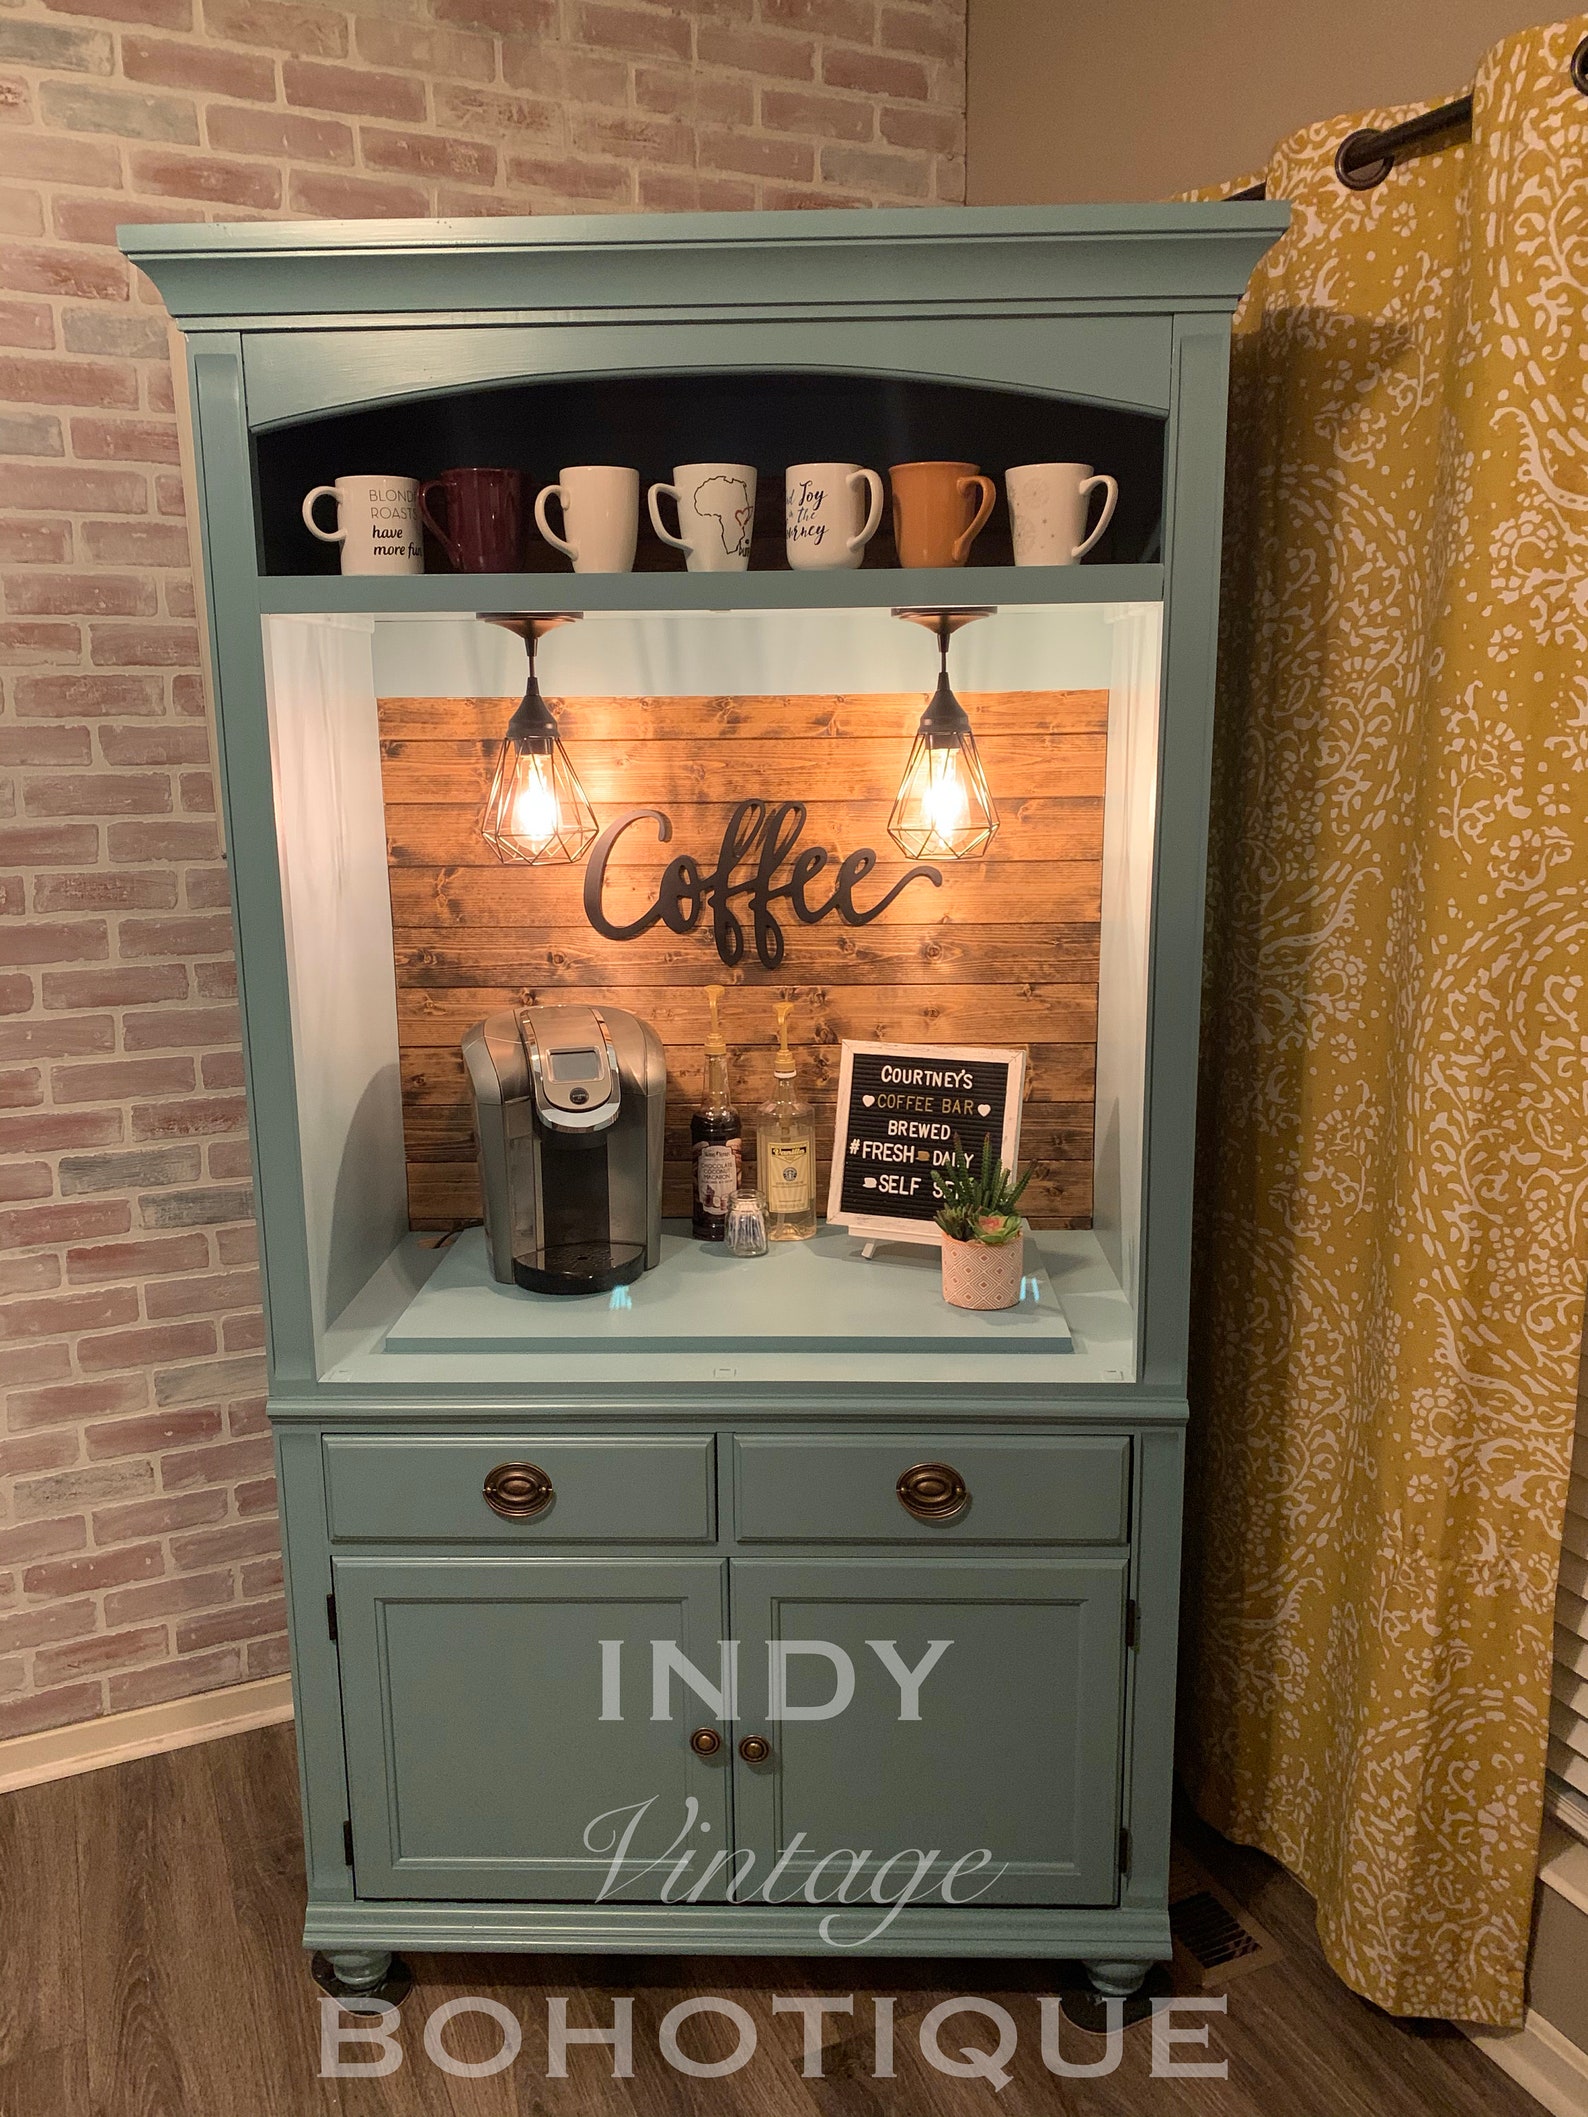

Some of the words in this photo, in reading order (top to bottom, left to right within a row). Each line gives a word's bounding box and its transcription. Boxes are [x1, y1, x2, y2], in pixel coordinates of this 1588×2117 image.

[798, 480, 829, 511] Joy
[797, 506, 816, 523] the
[372, 524, 403, 538] have
[373, 545, 406, 555] more
[583, 798, 943, 969] Coffee
[877, 1093, 934, 1113] COFFEE
[942, 1098, 974, 1115] BAR
[887, 1120, 951, 1140] BREWED
[849, 1139, 915, 1163] #FRESH
[932, 1150, 975, 1169] DAIY
[878, 1174, 922, 1196] SELF
